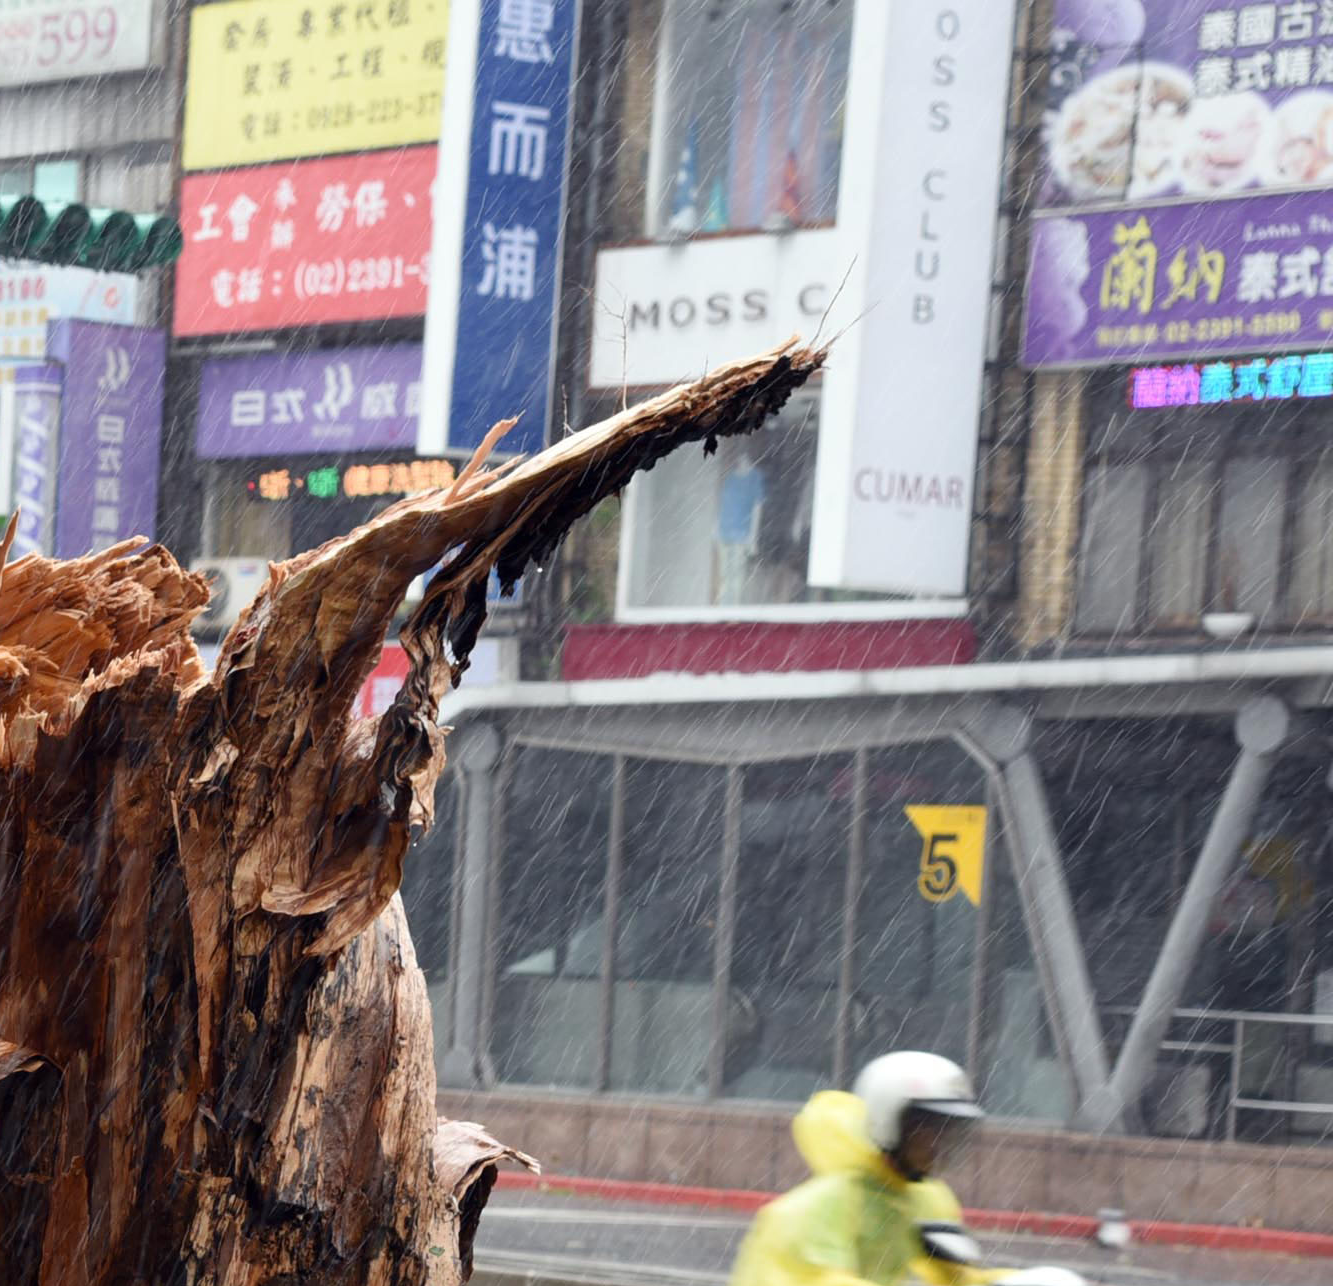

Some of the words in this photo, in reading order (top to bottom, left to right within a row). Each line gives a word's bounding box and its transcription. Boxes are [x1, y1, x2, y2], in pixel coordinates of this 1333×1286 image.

[36, 6, 118, 67] 599
[912, 169, 947, 325] CLUB
[1099, 216, 1226, 315] 蘭納
[630, 288, 769, 332] MOSS
[853, 467, 965, 509] CUMAR
[924, 833, 959, 895] 5
